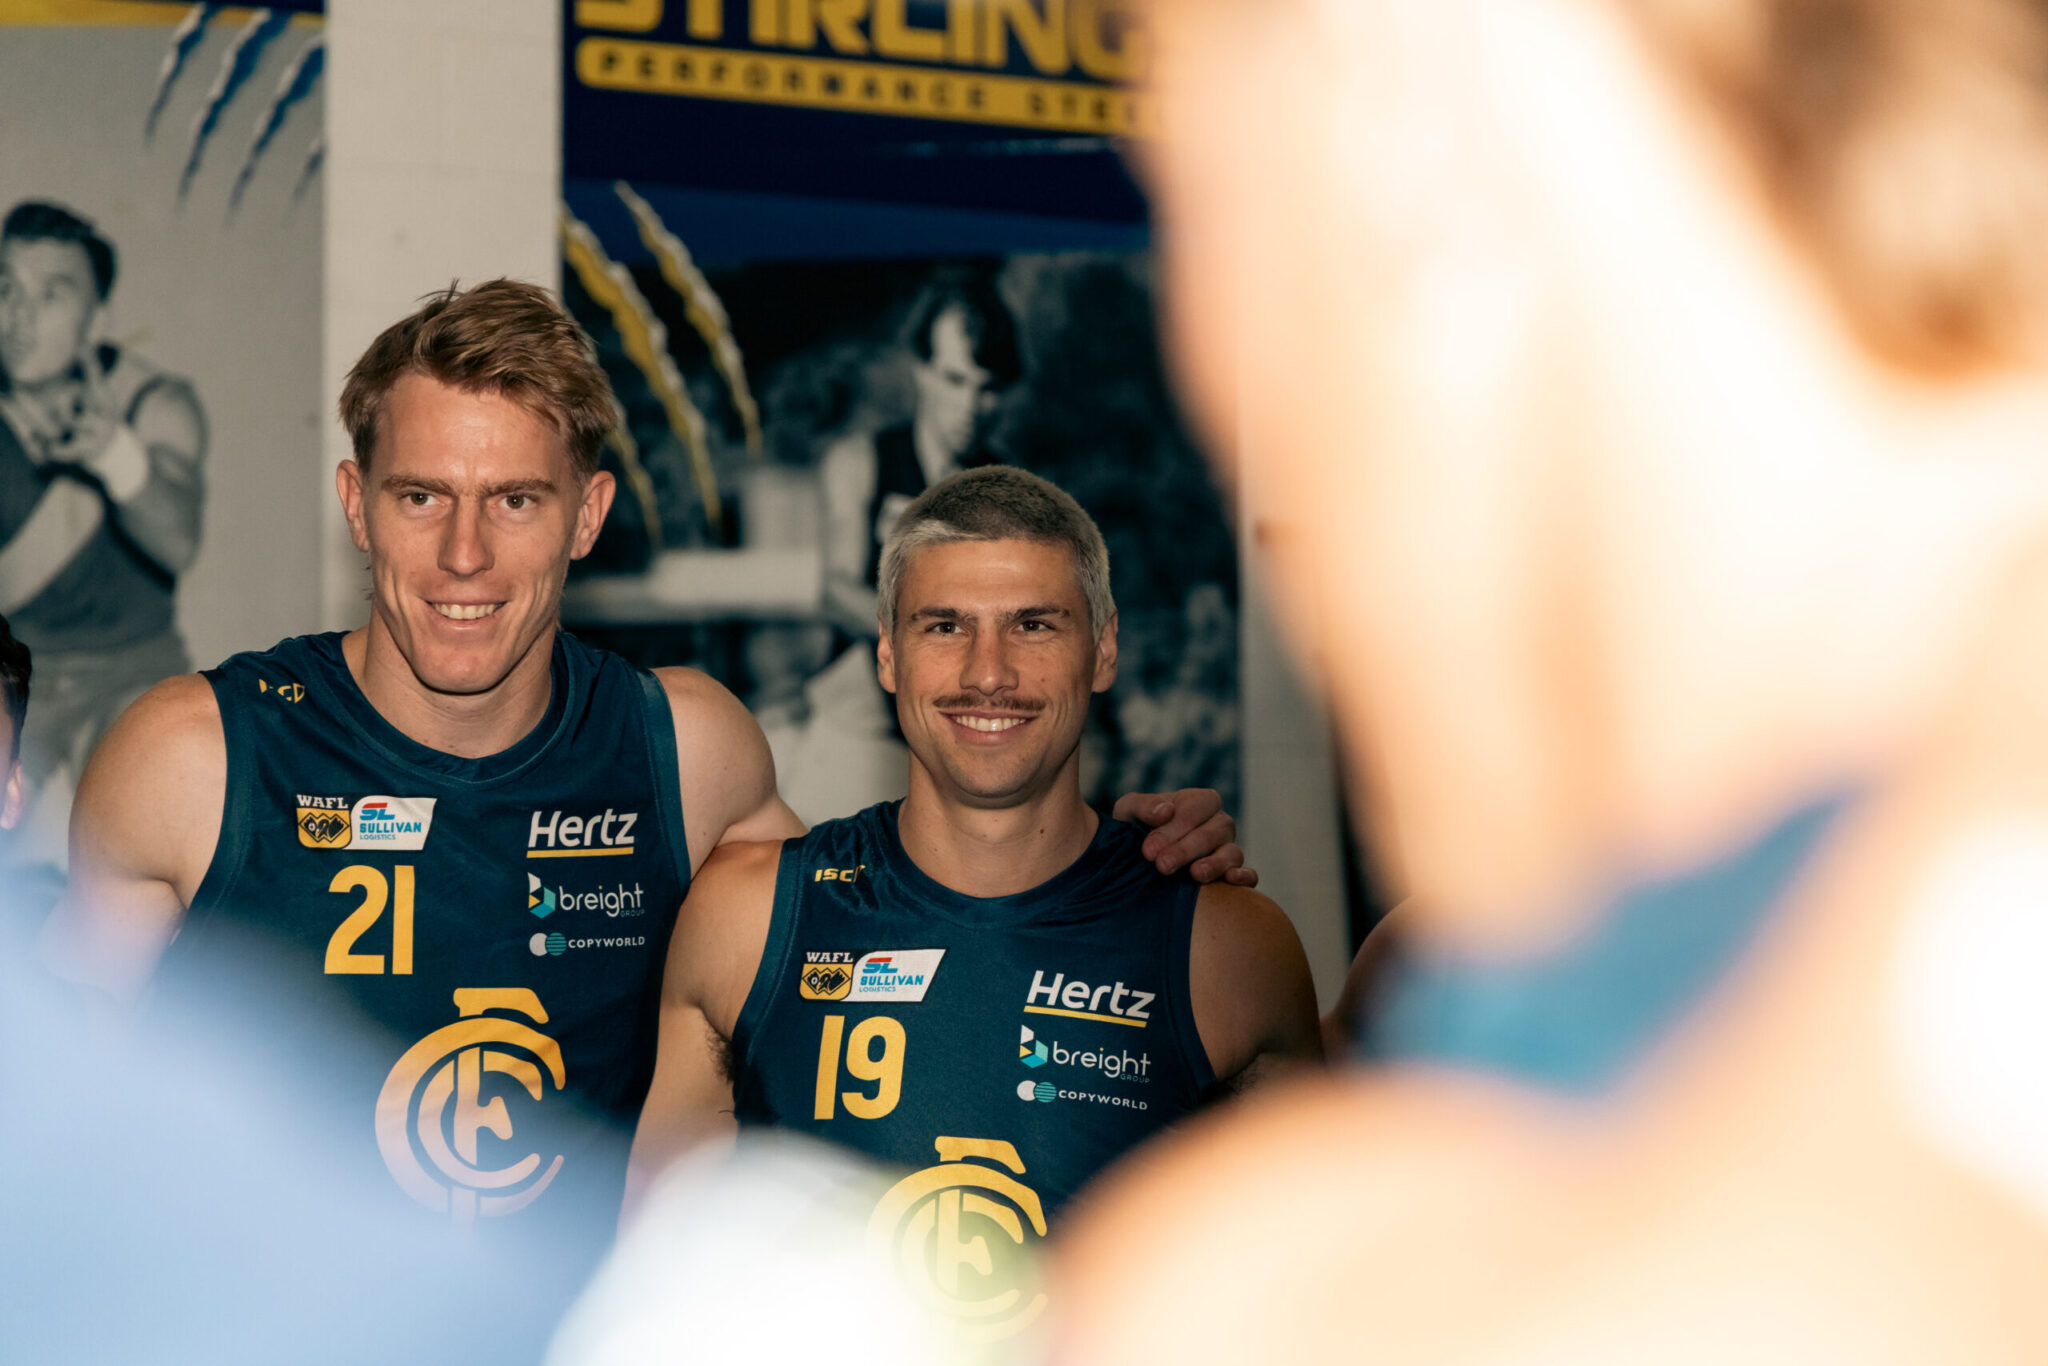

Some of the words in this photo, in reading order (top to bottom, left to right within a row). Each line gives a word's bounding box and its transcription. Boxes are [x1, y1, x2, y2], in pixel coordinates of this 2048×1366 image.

[601, 52, 984, 108] PERFORMANCE
[297, 794, 348, 809] WAFL
[359, 822, 422, 834] SULLIVAN
[527, 808, 638, 848] Hertz
[559, 882, 644, 918] breight
[324, 865, 415, 975] 21
[619, 908, 645, 918] GROUP
[568, 936, 646, 949] COPYWORLD
[806, 952, 854, 963] WAFL
[860, 975, 924, 986] SULLIVAN
[1026, 969, 1156, 1020] Hertz
[814, 1015, 907, 1120] 19
[1052, 1040, 1151, 1079] breight
[1120, 1073, 1150, 1084] GROUP
[1058, 1089, 1148, 1111] COPYWORLD
